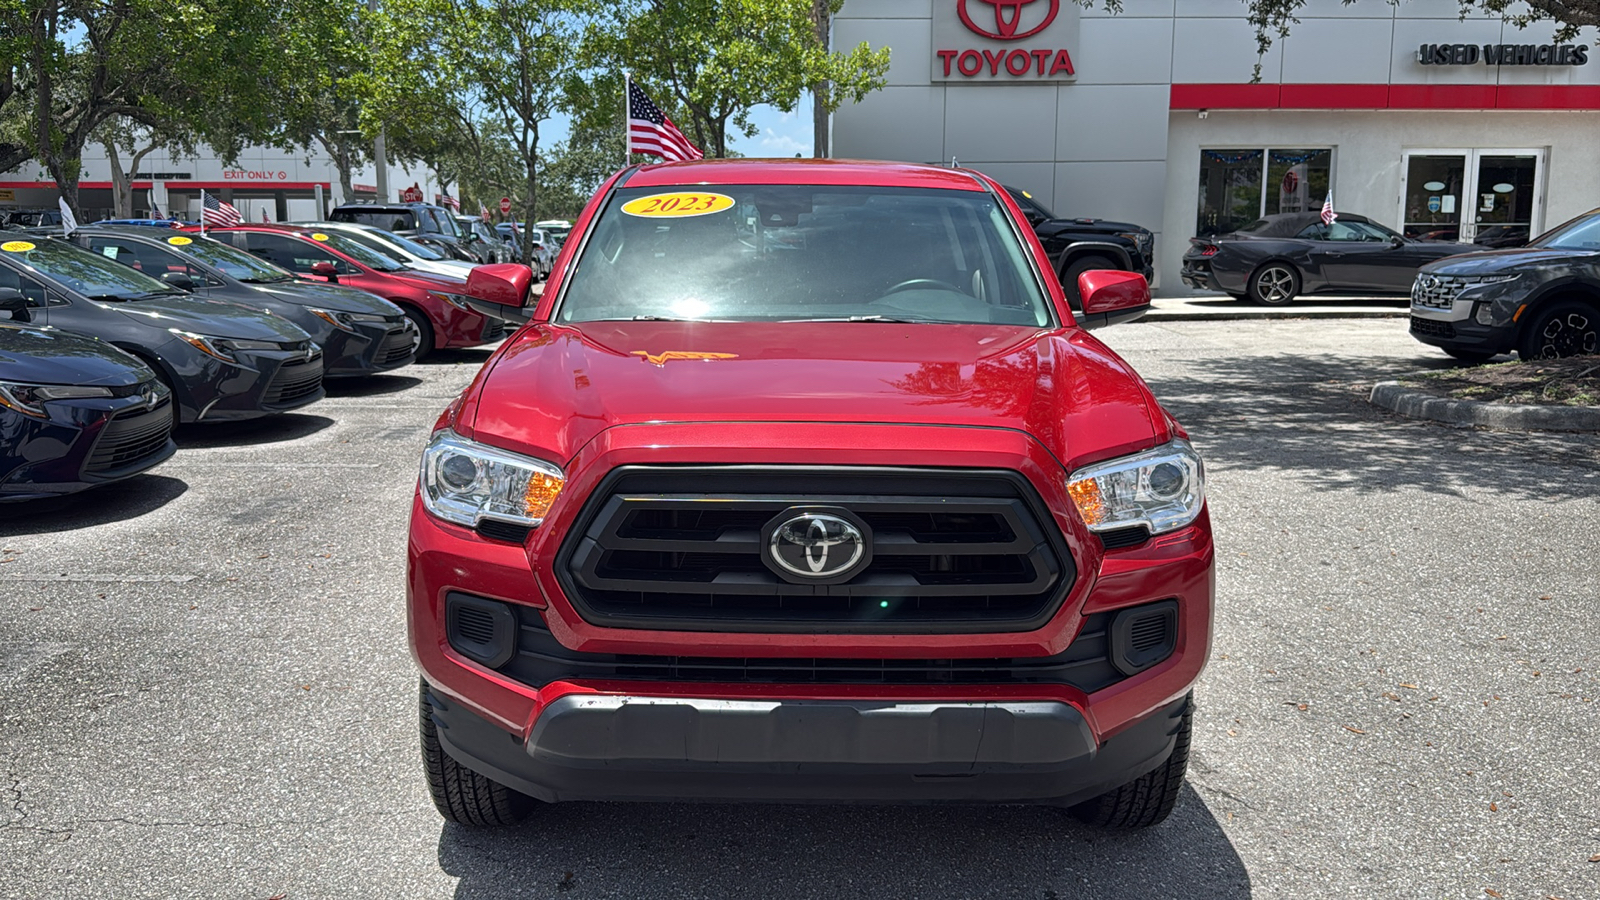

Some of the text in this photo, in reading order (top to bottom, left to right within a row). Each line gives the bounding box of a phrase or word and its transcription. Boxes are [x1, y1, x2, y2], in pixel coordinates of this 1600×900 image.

[937, 49, 1075, 77] TOYOTA
[1419, 44, 1589, 65] USED VEHICLES
[224, 171, 274, 179] EXIT ONLY
[640, 196, 717, 214] 2023
